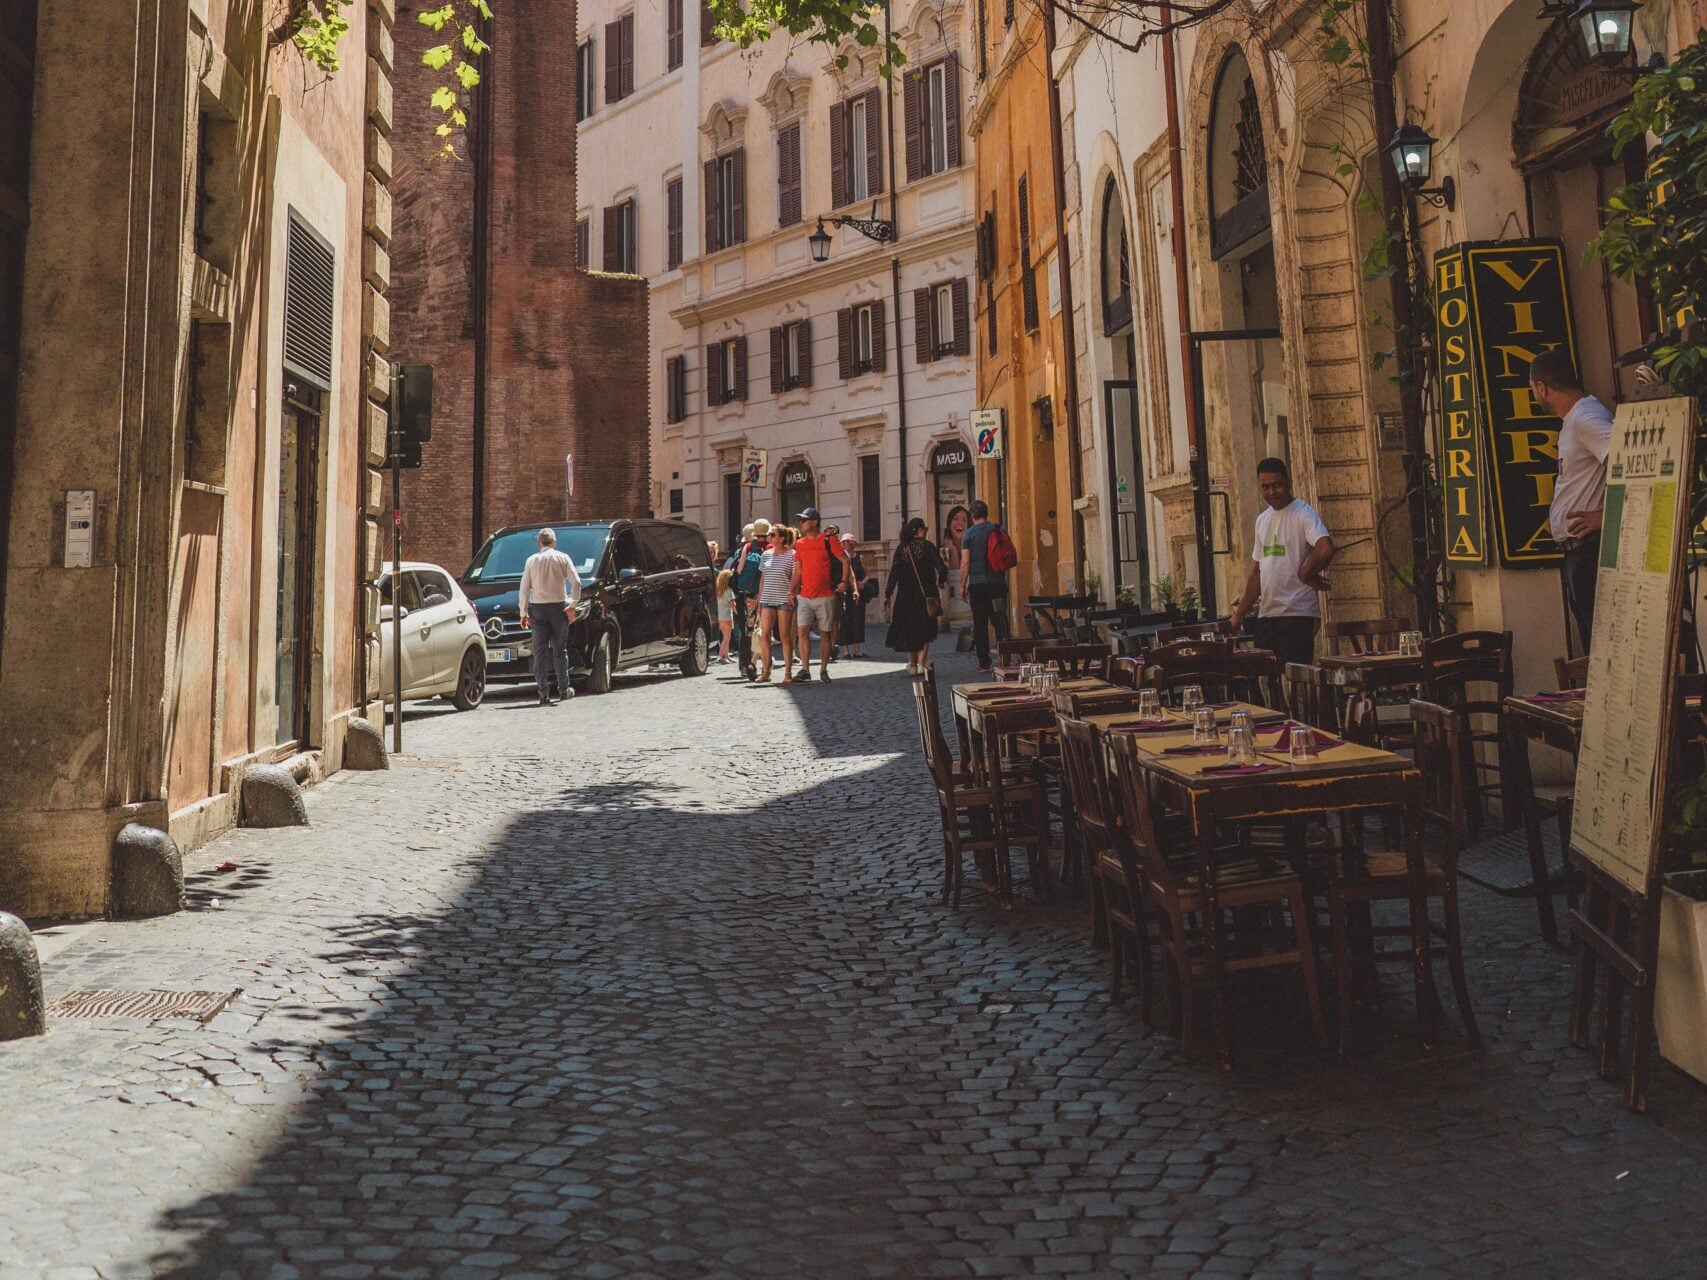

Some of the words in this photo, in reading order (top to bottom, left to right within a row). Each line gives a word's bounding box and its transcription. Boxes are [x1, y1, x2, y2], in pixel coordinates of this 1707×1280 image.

[1439, 259, 1479, 555] HOSTERIA
[936, 452, 965, 466] MABU
[786, 471, 808, 484] MABU
